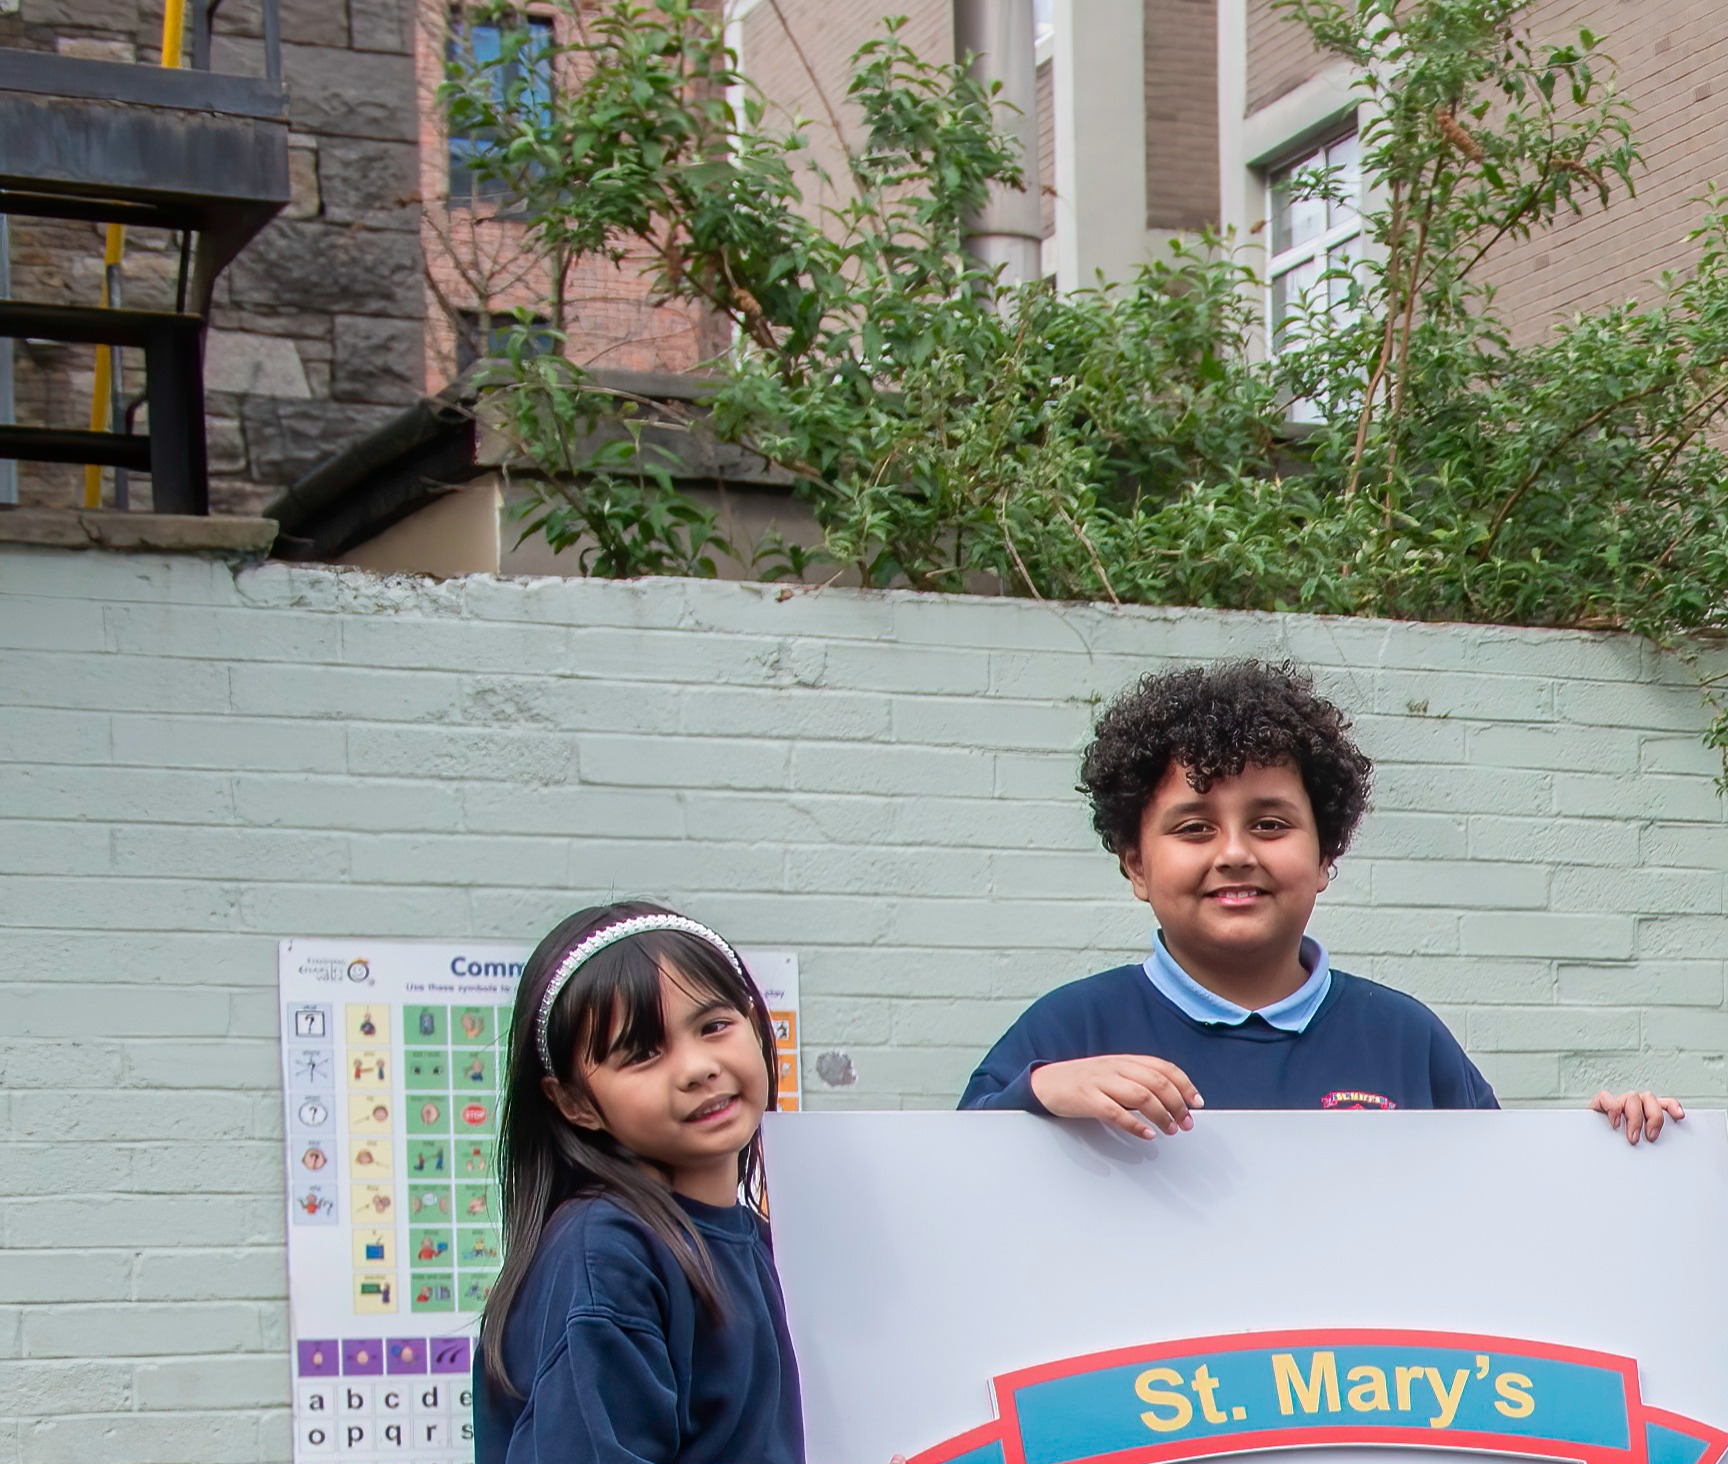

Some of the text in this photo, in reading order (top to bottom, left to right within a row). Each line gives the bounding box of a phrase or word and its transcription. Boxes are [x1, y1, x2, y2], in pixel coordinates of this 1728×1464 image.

[309, 1393, 325, 1411] a
[347, 1388, 364, 1409] b
[384, 1392, 400, 1409] c
[421, 1386, 438, 1408] d
[1135, 1351, 1536, 1433] St. Mary's
[308, 1423, 474, 1448] o p q r s
